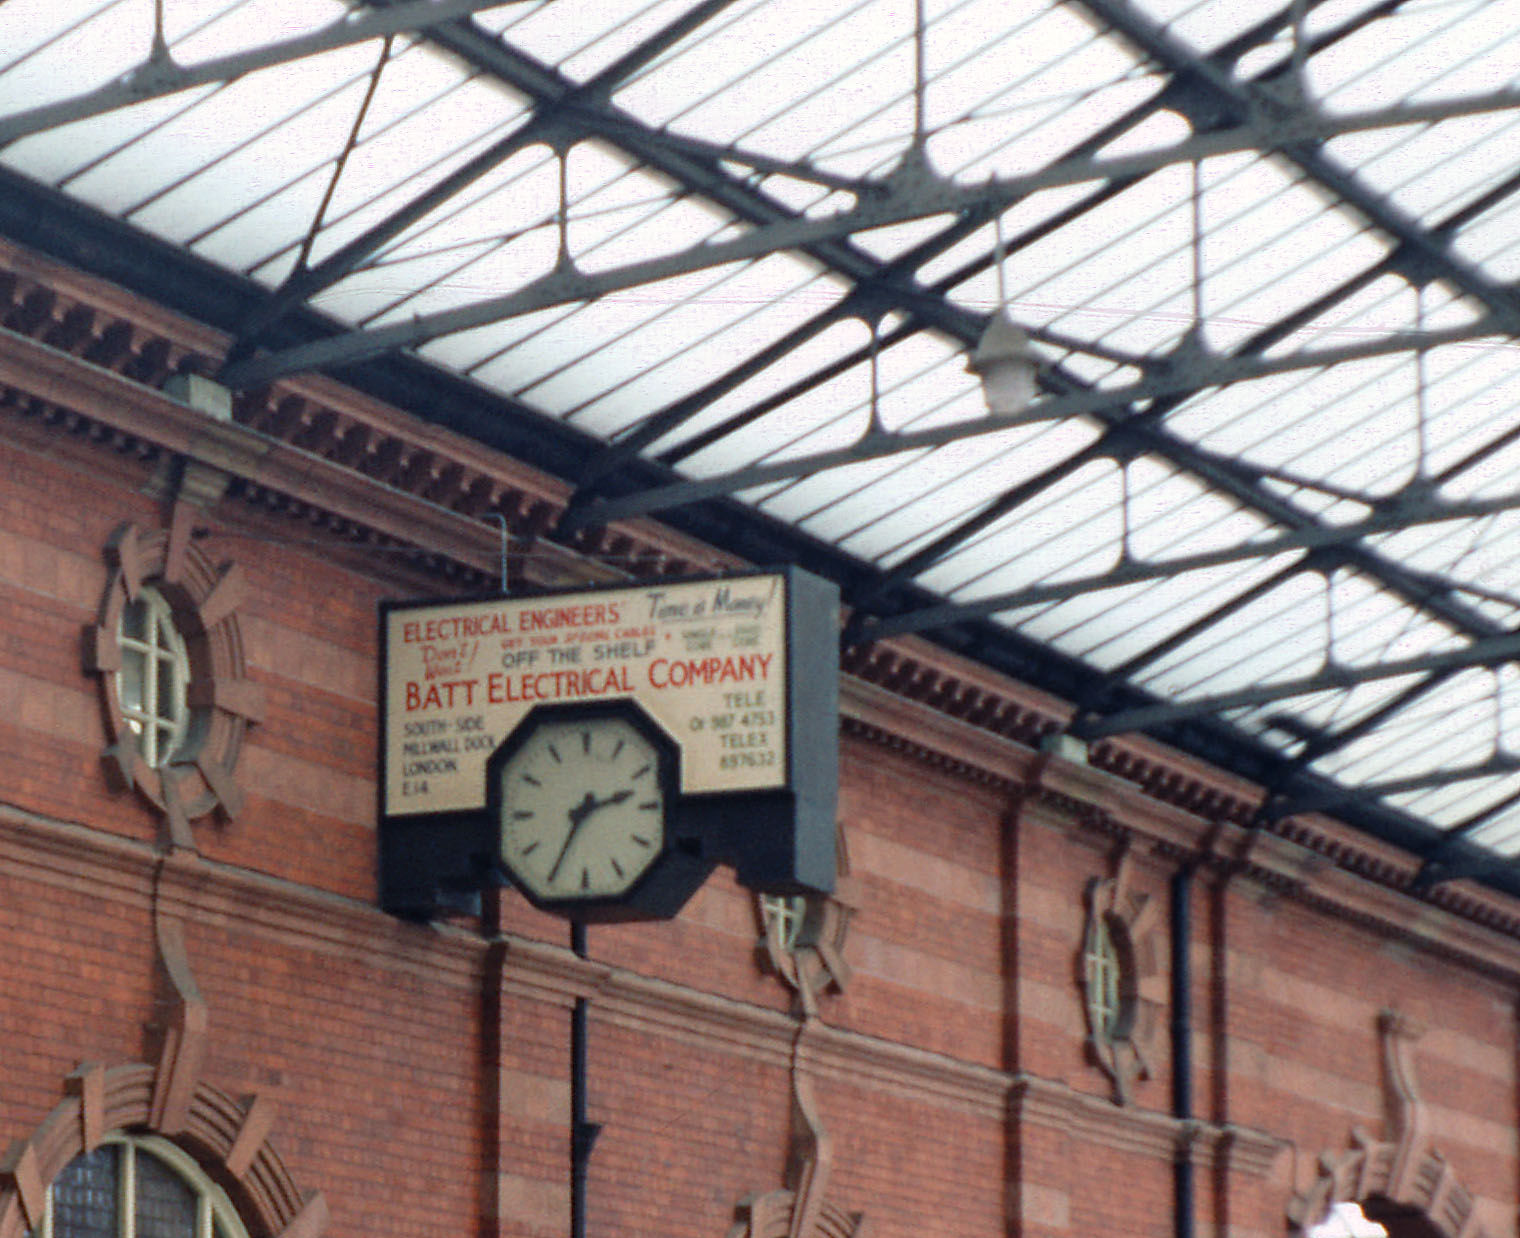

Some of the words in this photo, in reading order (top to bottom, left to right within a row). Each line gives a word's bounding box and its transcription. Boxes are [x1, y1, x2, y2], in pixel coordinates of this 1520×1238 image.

[403, 612, 512, 643] ELECTRICAL
[502, 651, 540, 668] OFF
[547, 646, 582, 663] THE
[593, 637, 656, 660] SHELF
[405, 679, 480, 712] BATT
[487, 664, 635, 704] ELECTRICAL
[648, 652, 773, 689] COMPANY
[403, 738, 459, 757] MILLWALL
[402, 758, 457, 777] LONDON
